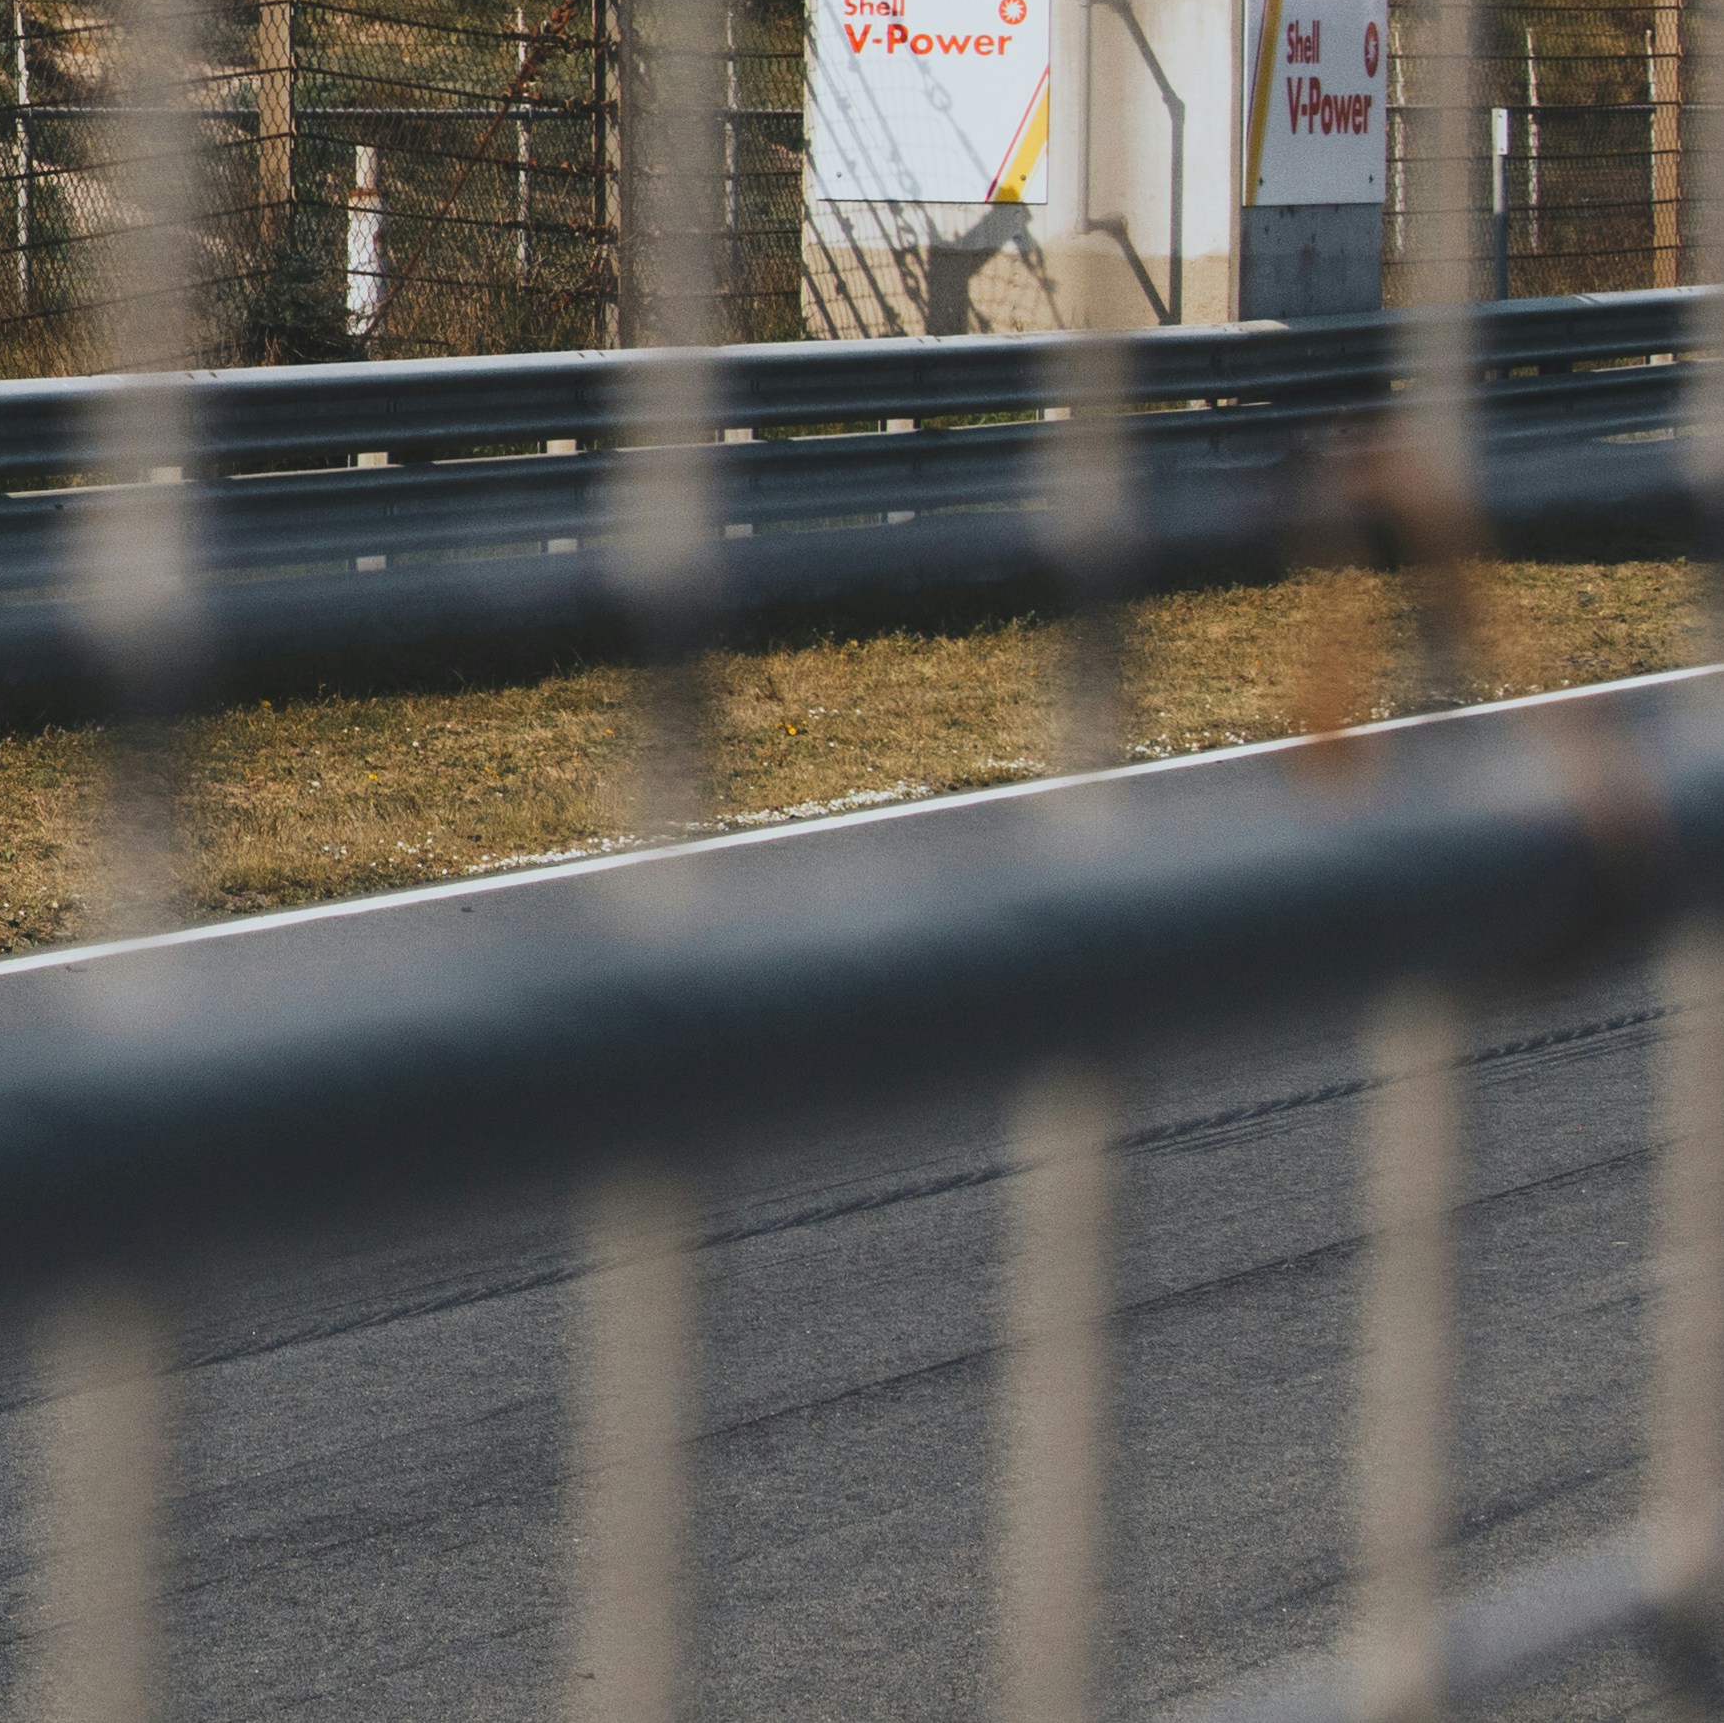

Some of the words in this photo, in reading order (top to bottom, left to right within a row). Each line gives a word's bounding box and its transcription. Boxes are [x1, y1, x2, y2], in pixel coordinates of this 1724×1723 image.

[845, 23, 1013, 56] V-Power
[1286, 20, 1321, 65] Shell
[1286, 77, 1372, 135] V-Power
